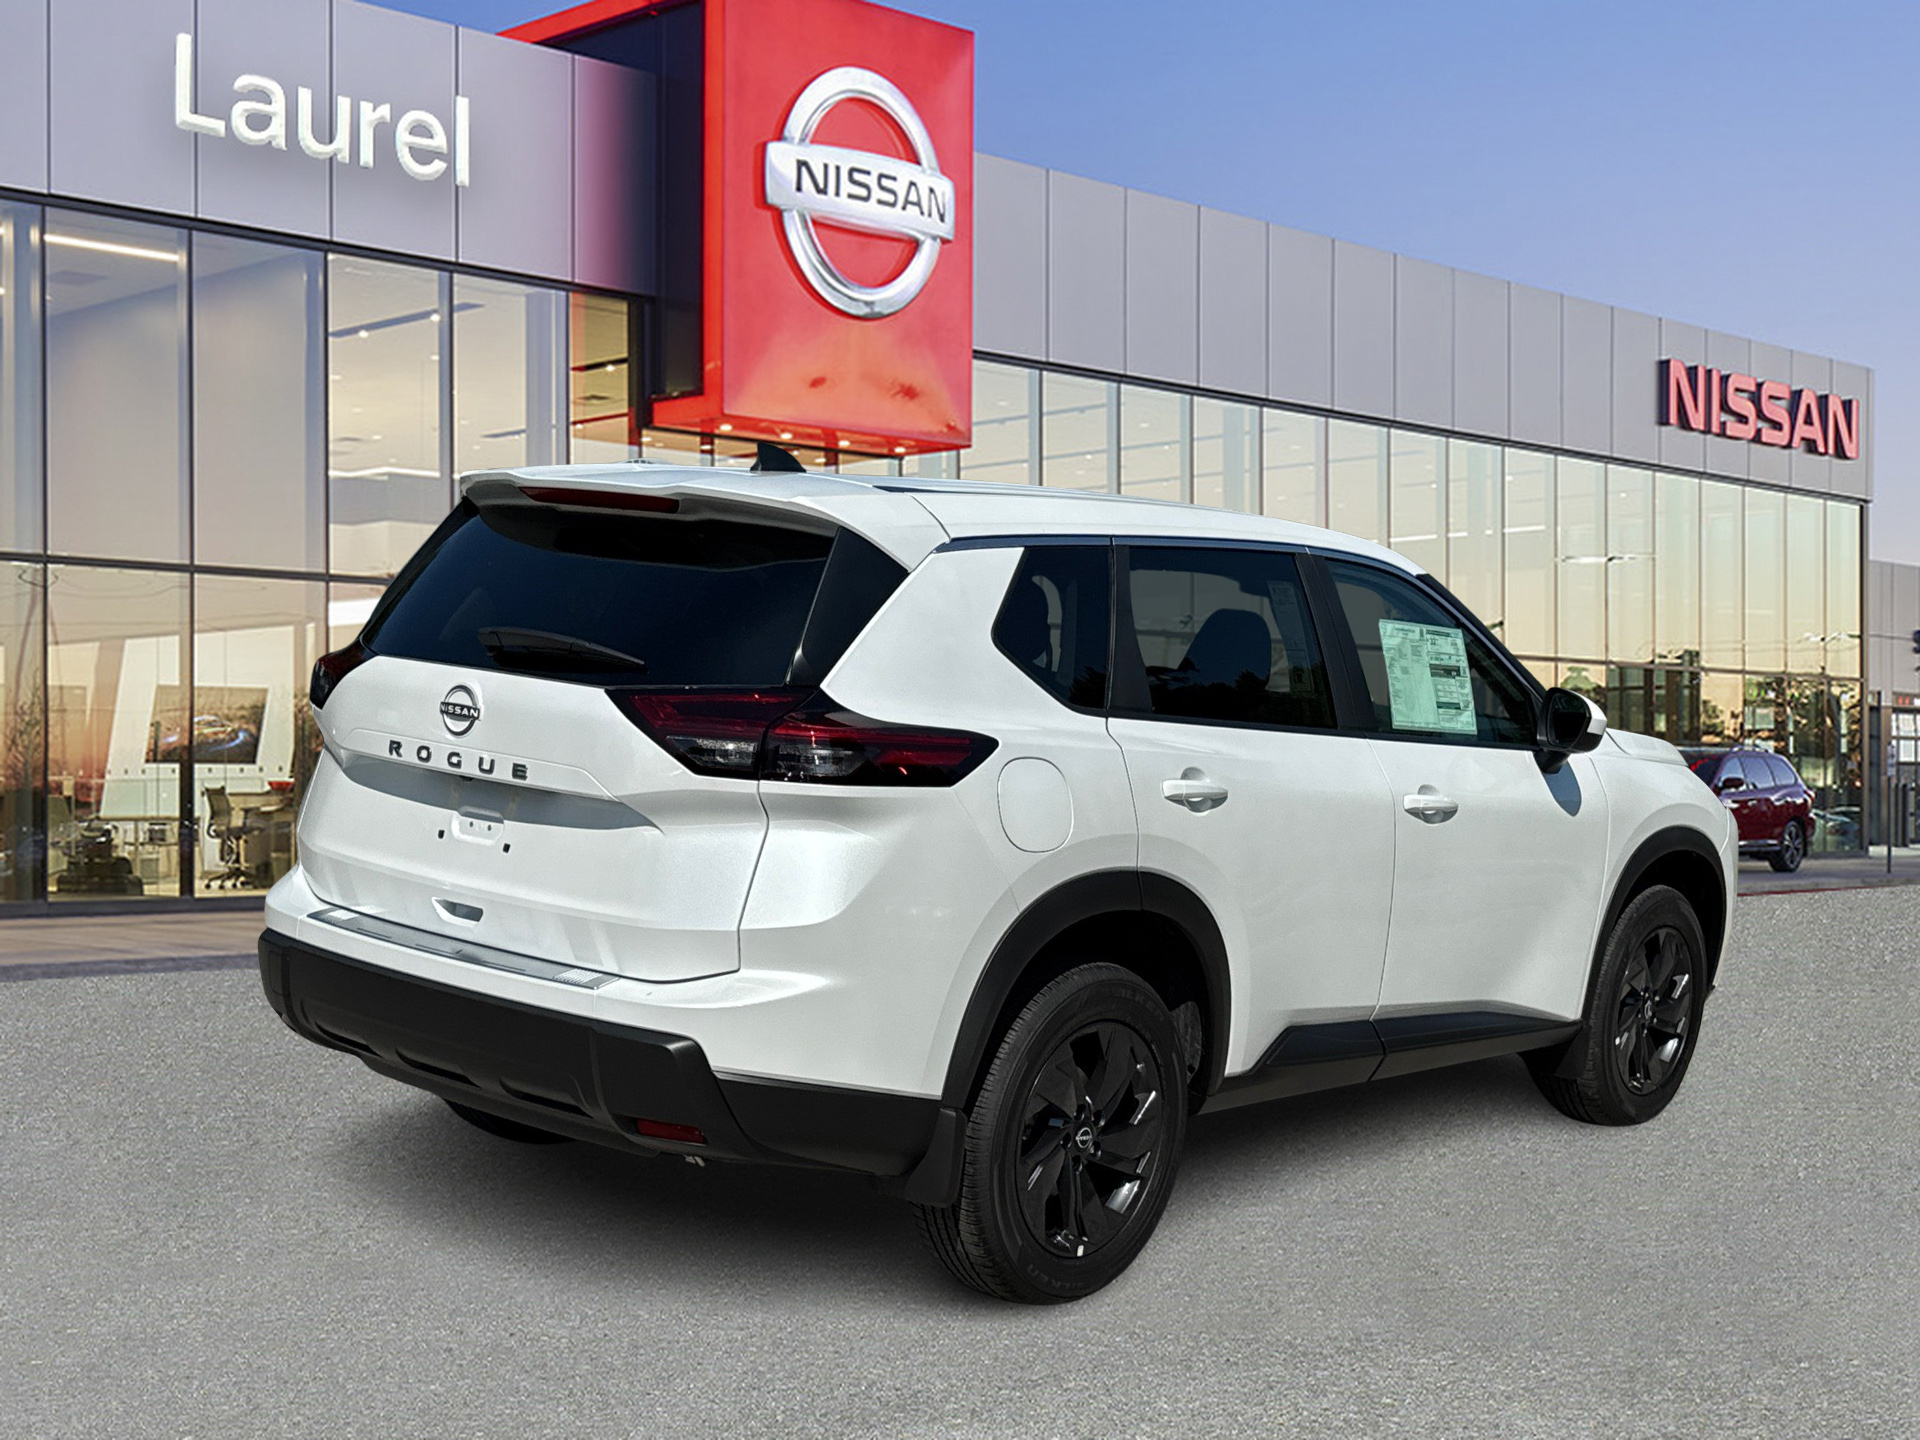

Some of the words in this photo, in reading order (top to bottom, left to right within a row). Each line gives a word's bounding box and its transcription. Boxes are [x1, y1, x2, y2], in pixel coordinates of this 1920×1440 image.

[175, 32, 470, 187] Laurel
[795, 158, 946, 223] NISSAN
[1658, 358, 1860, 460] NISSAN
[440, 703, 479, 719] NISSAN
[388, 739, 529, 781] ROGUE
